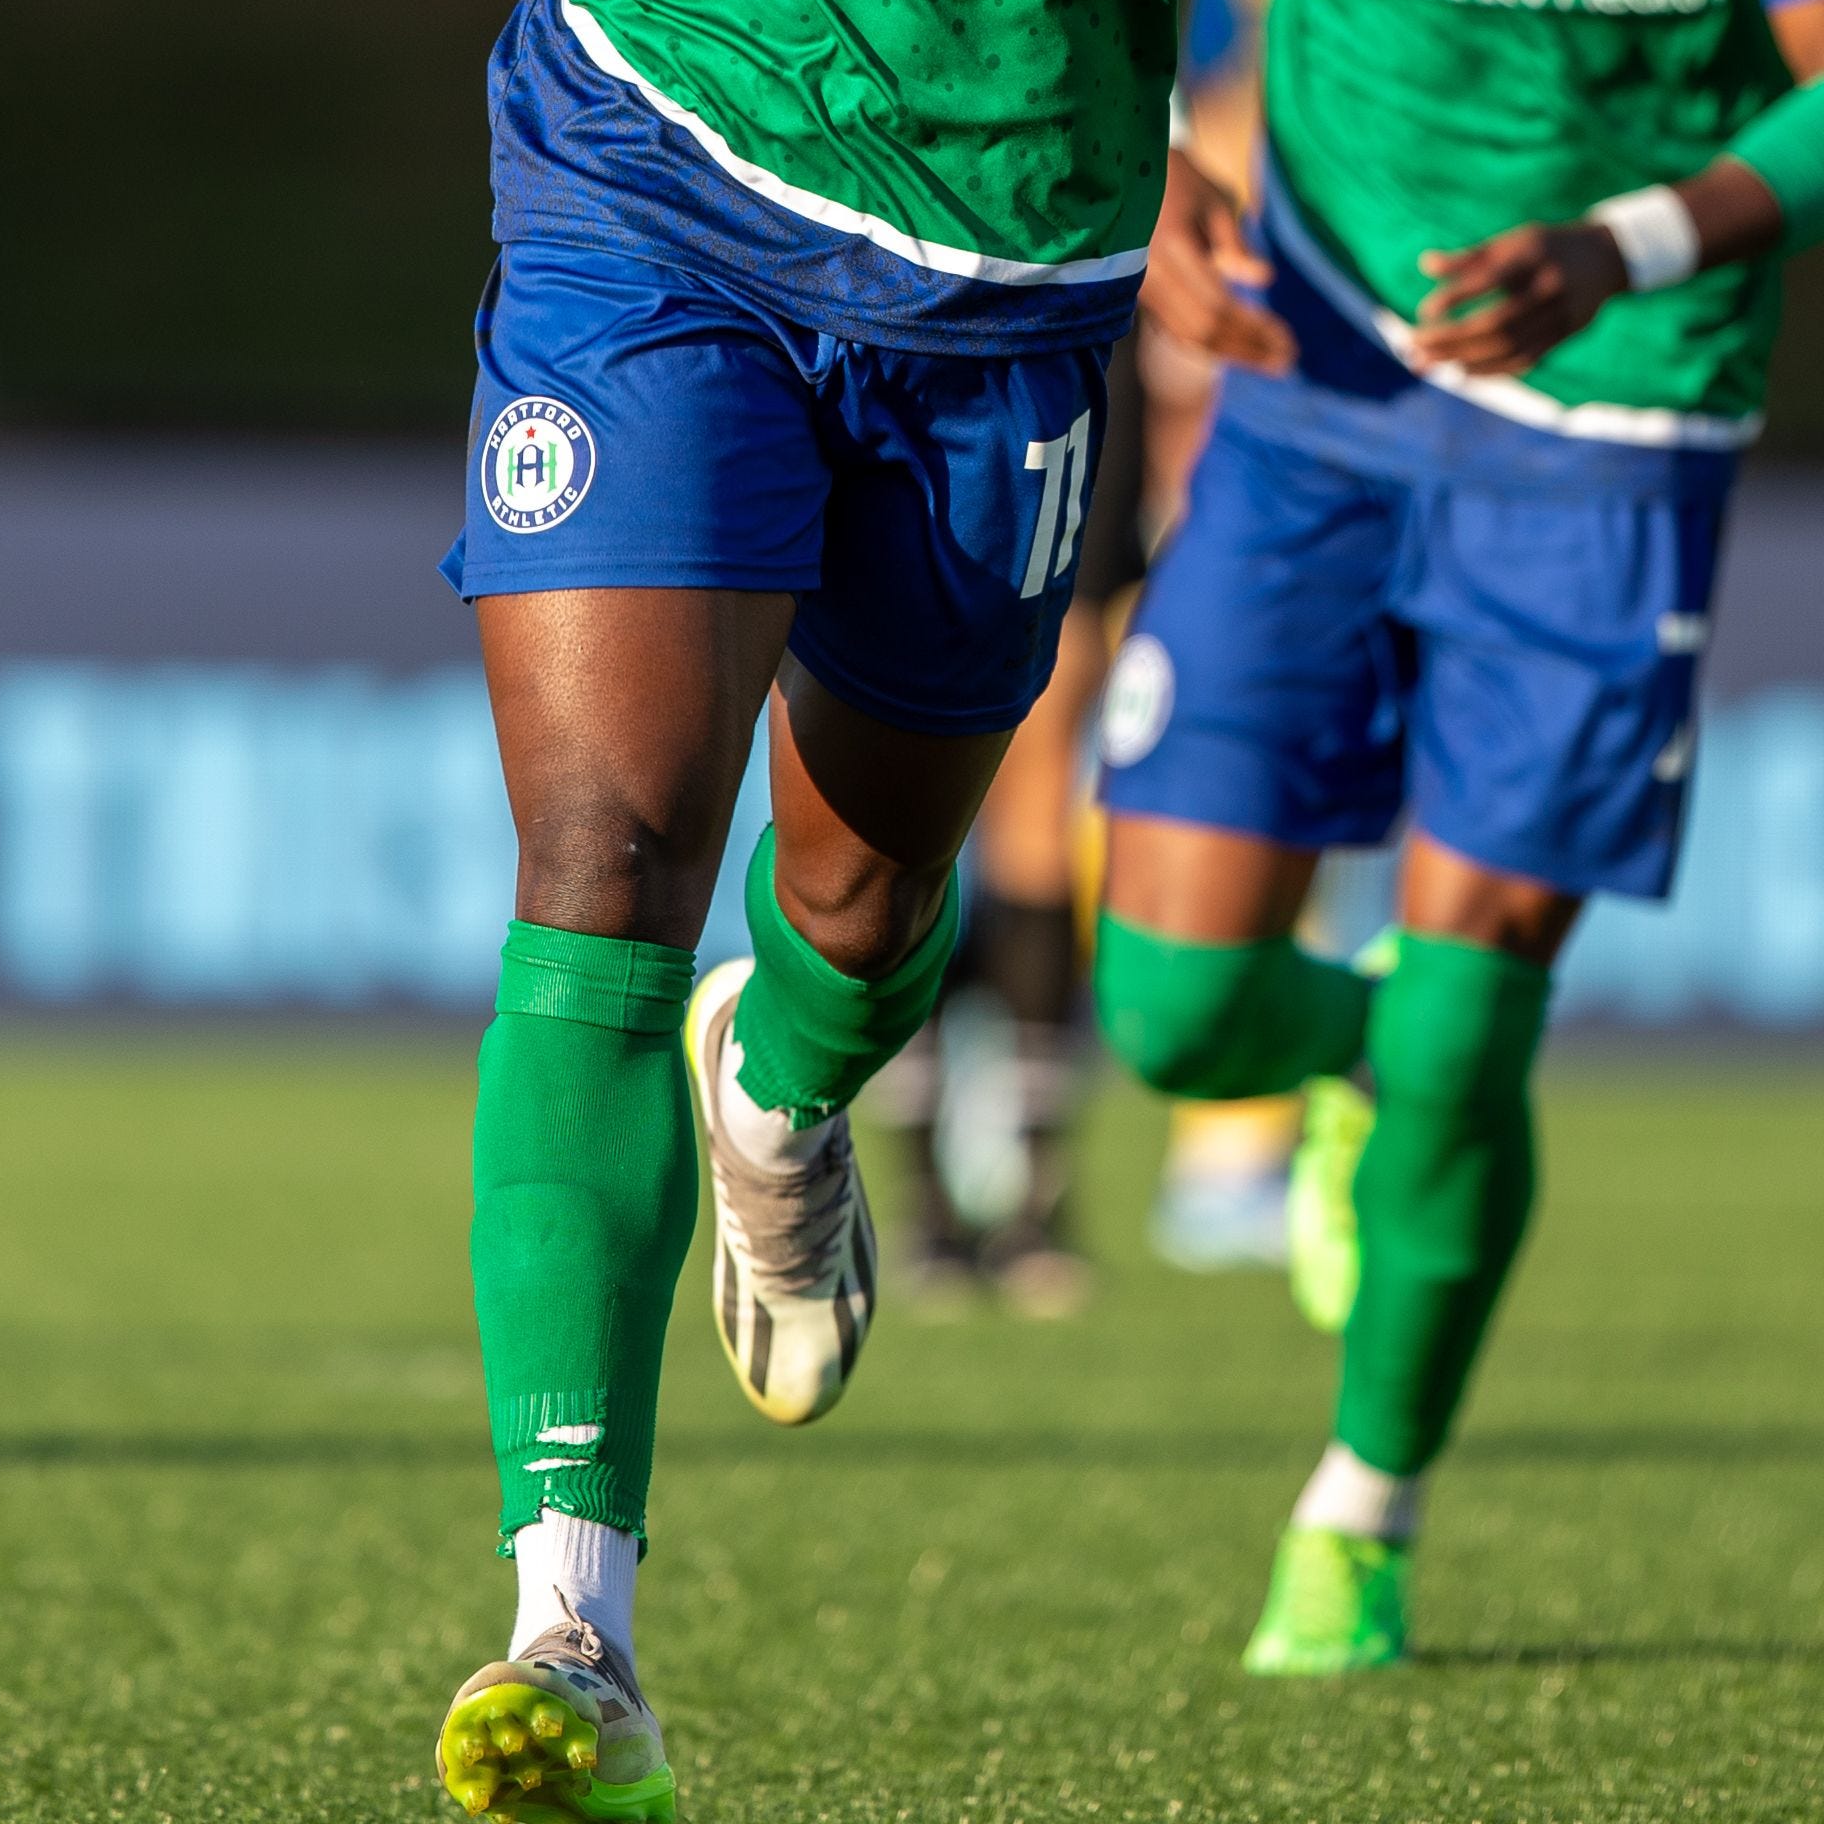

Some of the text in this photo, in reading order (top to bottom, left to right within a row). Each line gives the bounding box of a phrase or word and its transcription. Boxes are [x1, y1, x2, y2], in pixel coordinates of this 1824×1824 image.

[490, 403, 582, 450] HARTFORD
[492, 486, 578, 527] ATHLETIC
[1020, 408, 1091, 599] 11
